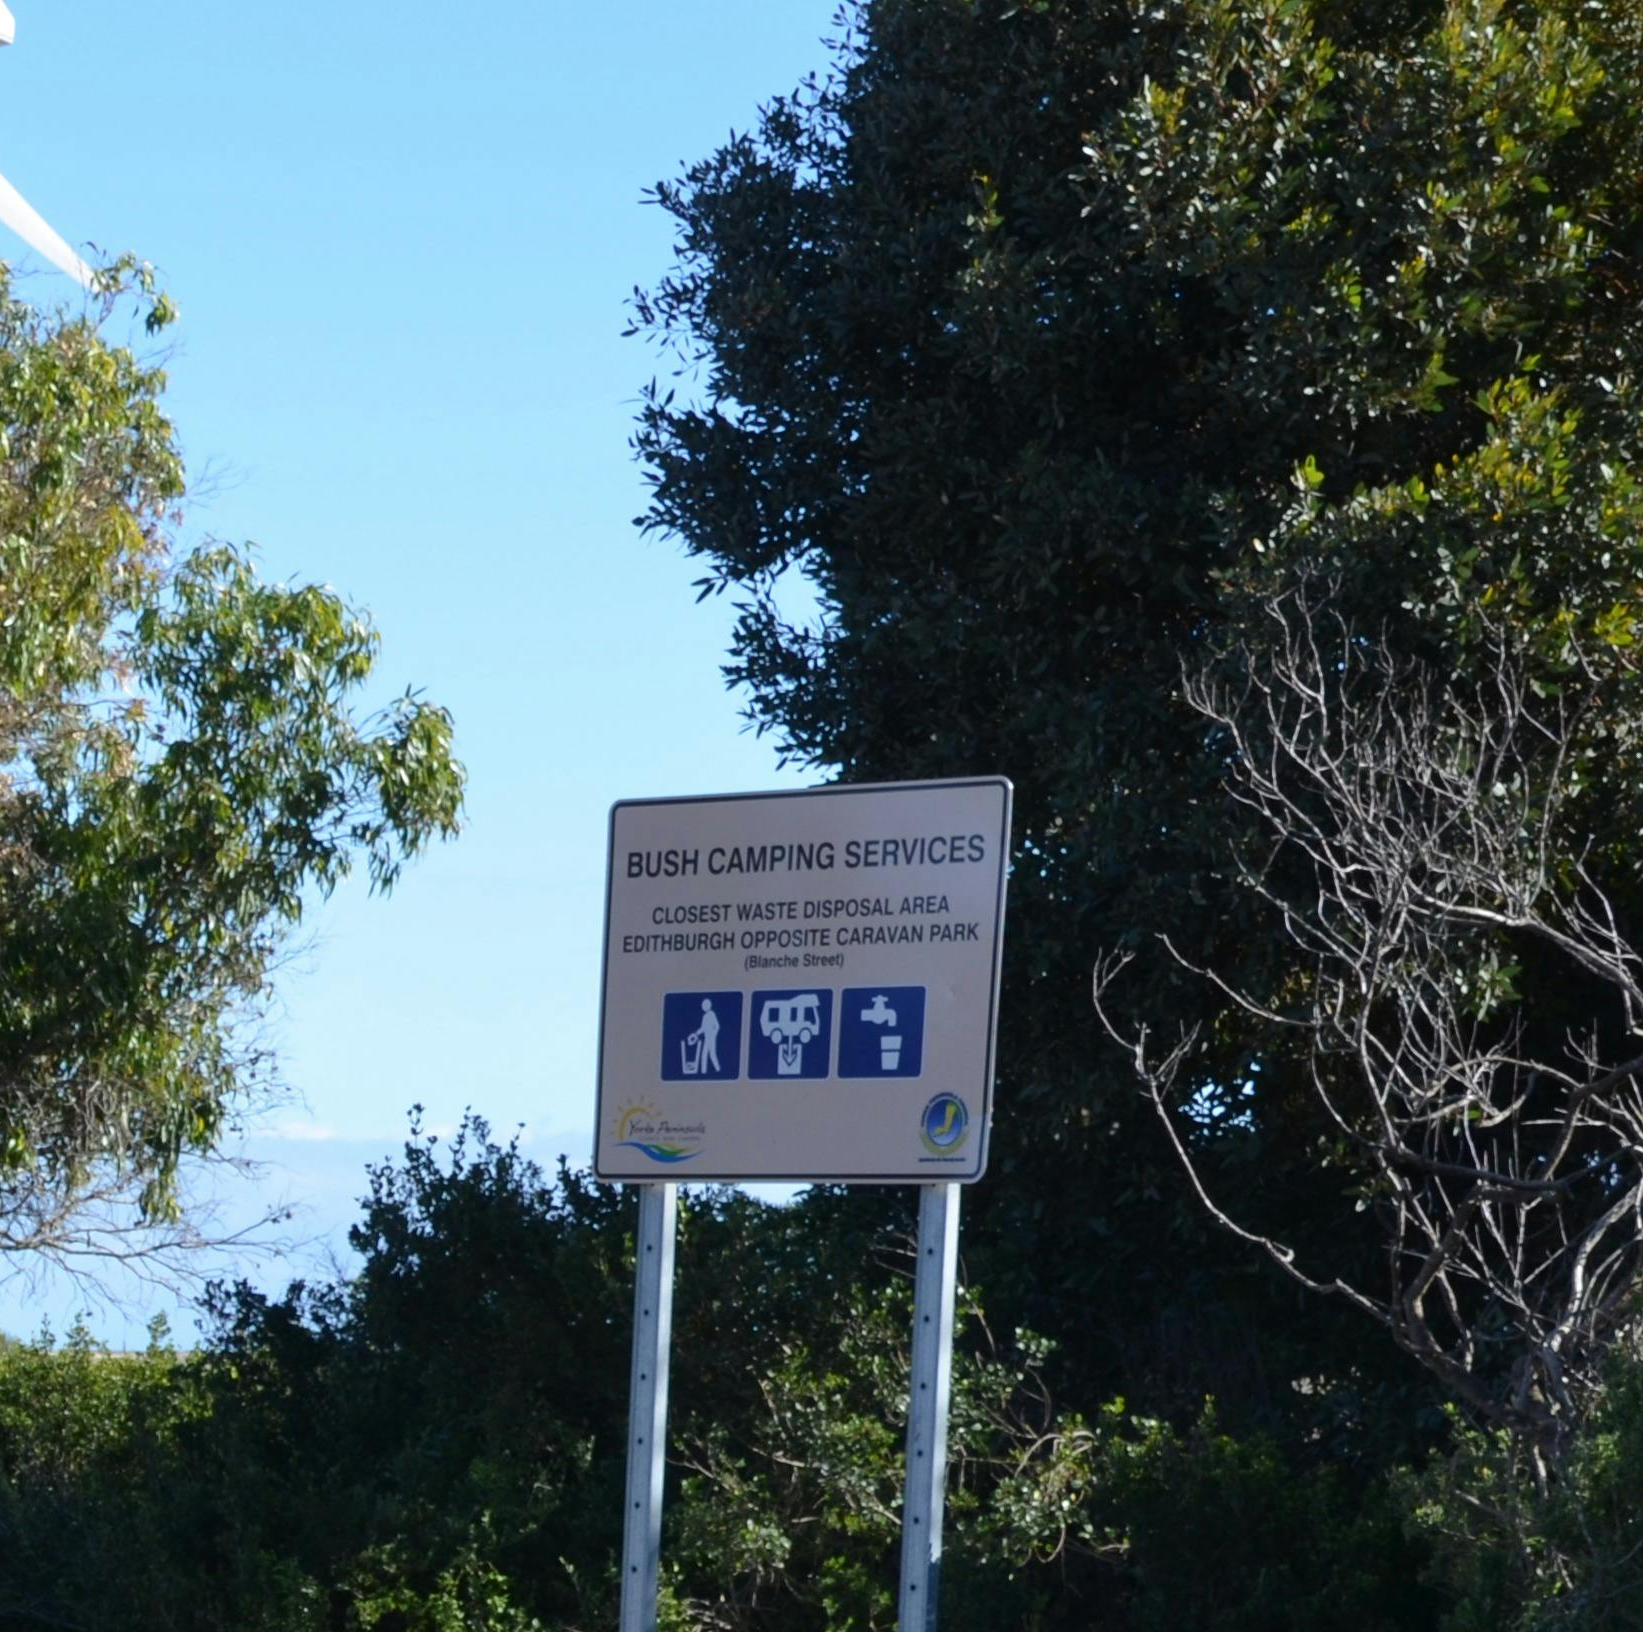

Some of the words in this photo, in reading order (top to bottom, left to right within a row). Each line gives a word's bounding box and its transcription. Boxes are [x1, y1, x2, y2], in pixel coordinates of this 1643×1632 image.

[627, 849, 699, 879] BUSH
[708, 842, 835, 875] CAMPING
[844, 834, 986, 869] SERVICES
[652, 904, 731, 925] CLOSEST
[737, 901, 797, 921] WASTE
[804, 897, 893, 919] DISPOSAL
[900, 895, 950, 915] AREA
[622, 931, 735, 953] EDITHBURGH
[740, 928, 830, 949] OPPOSITE
[836, 925, 923, 946] CARAVAN
[929, 922, 980, 942] PARK
[744, 954, 798, 972] (Blanche
[803, 952, 844, 970] Street)
